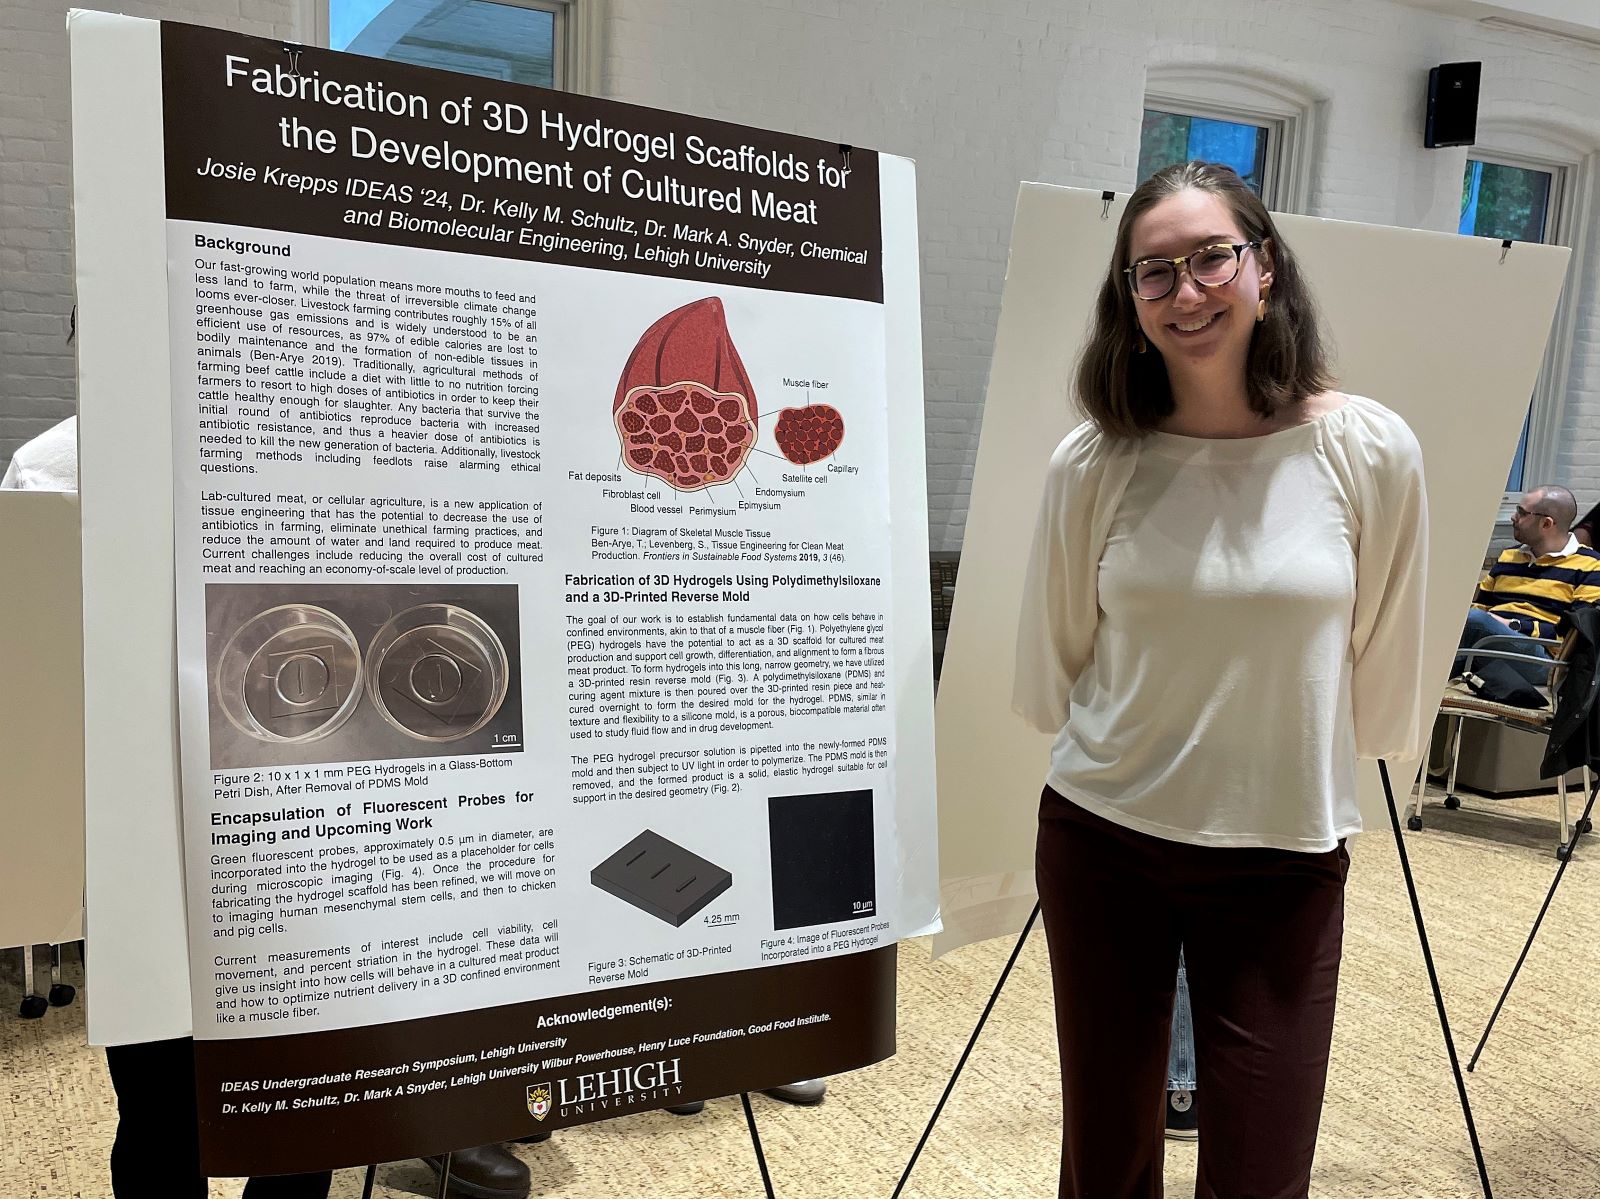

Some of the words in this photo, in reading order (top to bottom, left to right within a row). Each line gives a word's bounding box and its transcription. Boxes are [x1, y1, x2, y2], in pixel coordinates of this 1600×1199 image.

[226, 54, 428, 119] Fabrication
[440, 96, 472, 126] of
[483, 101, 528, 134] 3D
[541, 109, 674, 162] Hydrogel
[685, 135, 809, 182] Scaffolds
[816, 158, 849, 189] for
[278, 116, 336, 153] the
[351, 126, 573, 189] Development
[583, 165, 611, 193] of
[621, 169, 741, 213] Cultured
[751, 189, 817, 224] Meat
[197, 157, 256, 181] Josie
[263, 165, 338, 195] Krepps
[345, 178, 413, 203] IDEAS
[460, 193, 485, 213] Dr.
[493, 198, 538, 224] Kelly
[543, 205, 563, 224] M.
[570, 209, 637, 236] Schultz,
[644, 219, 666, 237] Dr.
[673, 223, 713, 244] Mark
[715, 230, 731, 246] A.
[737, 232, 794, 257] Snyder,
[800, 241, 867, 264] Chemical
[194, 234, 290, 257] Background
[343, 209, 382, 226] and
[388, 210, 514, 242] Biomolecular
[518, 227, 627, 261] Engineering,
[634, 242, 689, 267] Lehigh
[695, 250, 771, 279] University
[194, 258, 216, 270] Our
[220, 260, 287, 279] fast-growing
[290, 270, 319, 281] world
[322, 274, 376, 287] population
[379, 280, 413, 291] means
[416, 284, 441, 294] more
[444, 287, 480, 298] mouths
[483, 290, 492, 299] to
[495, 290, 515, 301] feed
[518, 295, 535, 303] and
[782, 377, 810, 387] Muscle
[811, 379, 828, 388] fiber
[568, 470, 582, 480] Fat
[585, 471, 621, 482] deposits
[782, 473, 812, 483] Satellite
[814, 475, 827, 483] cell
[827, 463, 858, 475] Capillary
[602, 489, 644, 499] Fibroblast
[646, 491, 660, 500] cell
[755, 487, 805, 498] Endomysium
[630, 503, 654, 513] Blood
[656, 505, 682, 514] vessel
[689, 506, 736, 517] Perimysium
[591, 525, 618, 537] Figure
[621, 526, 628, 535] 1:
[631, 526, 667, 538] Diagram
[669, 527, 677, 536] of
[679, 527, 712, 536] Skeletal
[714, 528, 743, 537] Muscle
[745, 529, 770, 537] Tissue
[565, 574, 634, 585] Fabrication
[638, 574, 650, 585] of
[653, 574, 669, 585] 3D
[673, 574, 732, 588] Hydrogels
[736, 574, 768, 588] Using
[772, 574, 880, 588] Polydimethylsiloxane
[565, 591, 588, 602] and
[592, 593, 599, 602] a
[603, 591, 667, 602] 3D-Printed
[671, 591, 718, 602] Reverse
[722, 590, 749, 601] Mold
[494, 734, 498, 742] 1
[502, 734, 516, 742] cm
[213, 774, 250, 786] Figure
[253, 772, 263, 782] 2:
[268, 771, 281, 781] 10
[284, 772, 291, 780] x
[294, 770, 299, 779] 1
[304, 771, 310, 779] x
[314, 769, 318, 778] 1
[323, 769, 343, 777] mm
[347, 765, 371, 776] PEG
[374, 763, 425, 776] Hydrogels
[428, 763, 436, 771] in
[448, 758, 512, 770] Glass-Bottom
[214, 787, 240, 799] Petri
[244, 786, 272, 797] Dish,
[275, 784, 302, 795] After
[305, 780, 351, 793] Removal
[355, 779, 365, 789] of
[368, 777, 401, 788] PDMS
[404, 775, 428, 786] Mold
[211, 806, 324, 826] Encapsulation
[336, 803, 351, 816] of
[363, 797, 447, 814] Fluorescent
[458, 793, 505, 807] Probes
[515, 791, 534, 802] for
[211, 829, 276, 846] Imaging
[281, 825, 310, 840] and
[315, 820, 391, 839] Upcoming
[395, 816, 432, 830] Work
[210, 854, 246, 865] Green
[251, 848, 313, 862] fluorescent
[318, 845, 358, 859] probes,
[364, 838, 433, 854] approximately
[438, 835, 453, 845] 0.5
[491, 830, 533, 841] diameter,
[538, 828, 553, 836] are
[852, 900, 861, 910] 10
[703, 914, 722, 924] 4.25
[724, 913, 739, 921] mm
[588, 961, 615, 972] Figure
[618, 958, 626, 967] 3:
[629, 951, 674, 965] Schematic
[676, 949, 684, 959] of
[686, 944, 731, 958] 3D-Printed
[588, 972, 625, 984] Reverse
[627, 967, 648, 978] Mold
[536, 996, 672, 1028] Acknowledgement(s):
[221, 1080, 259, 1092] IDEAS
[262, 1072, 351, 1089] Undergraduate
[354, 1063, 409, 1079] Research
[412, 1053, 477, 1073] Symposium,
[480, 1045, 515, 1059] Lehigh
[517, 1037, 567, 1053] University
[222, 1103, 237, 1113] Dr.
[241, 1102, 272, 1113] Kelly
[274, 1099, 288, 1110] M.
[292, 1095, 339, 1109] Schultz,
[343, 1092, 359, 1103] Dr.
[363, 1087, 392, 1100] Mark
[394, 1085, 403, 1096] A
[406, 1080, 447, 1094] Snyder,
[450, 1071, 486, 1086] Lehigh
[489, 1062, 539, 1079] University
[541, 1057, 573, 1069] Wilbur
[574, 1046, 636, 1063] Powerhouse,
[638, 1041, 666, 1052] Henry
[668, 1037, 690, 1047] Luce
[692, 1028, 745, 1043] Foundation,
[748, 1022, 772, 1034] Good
[773, 1018, 795, 1030] Food
[796, 1013, 831, 1025] Institute.
[557, 1058, 681, 1105] LEHIGH
[560, 1085, 682, 1117] UNIVERSITY
